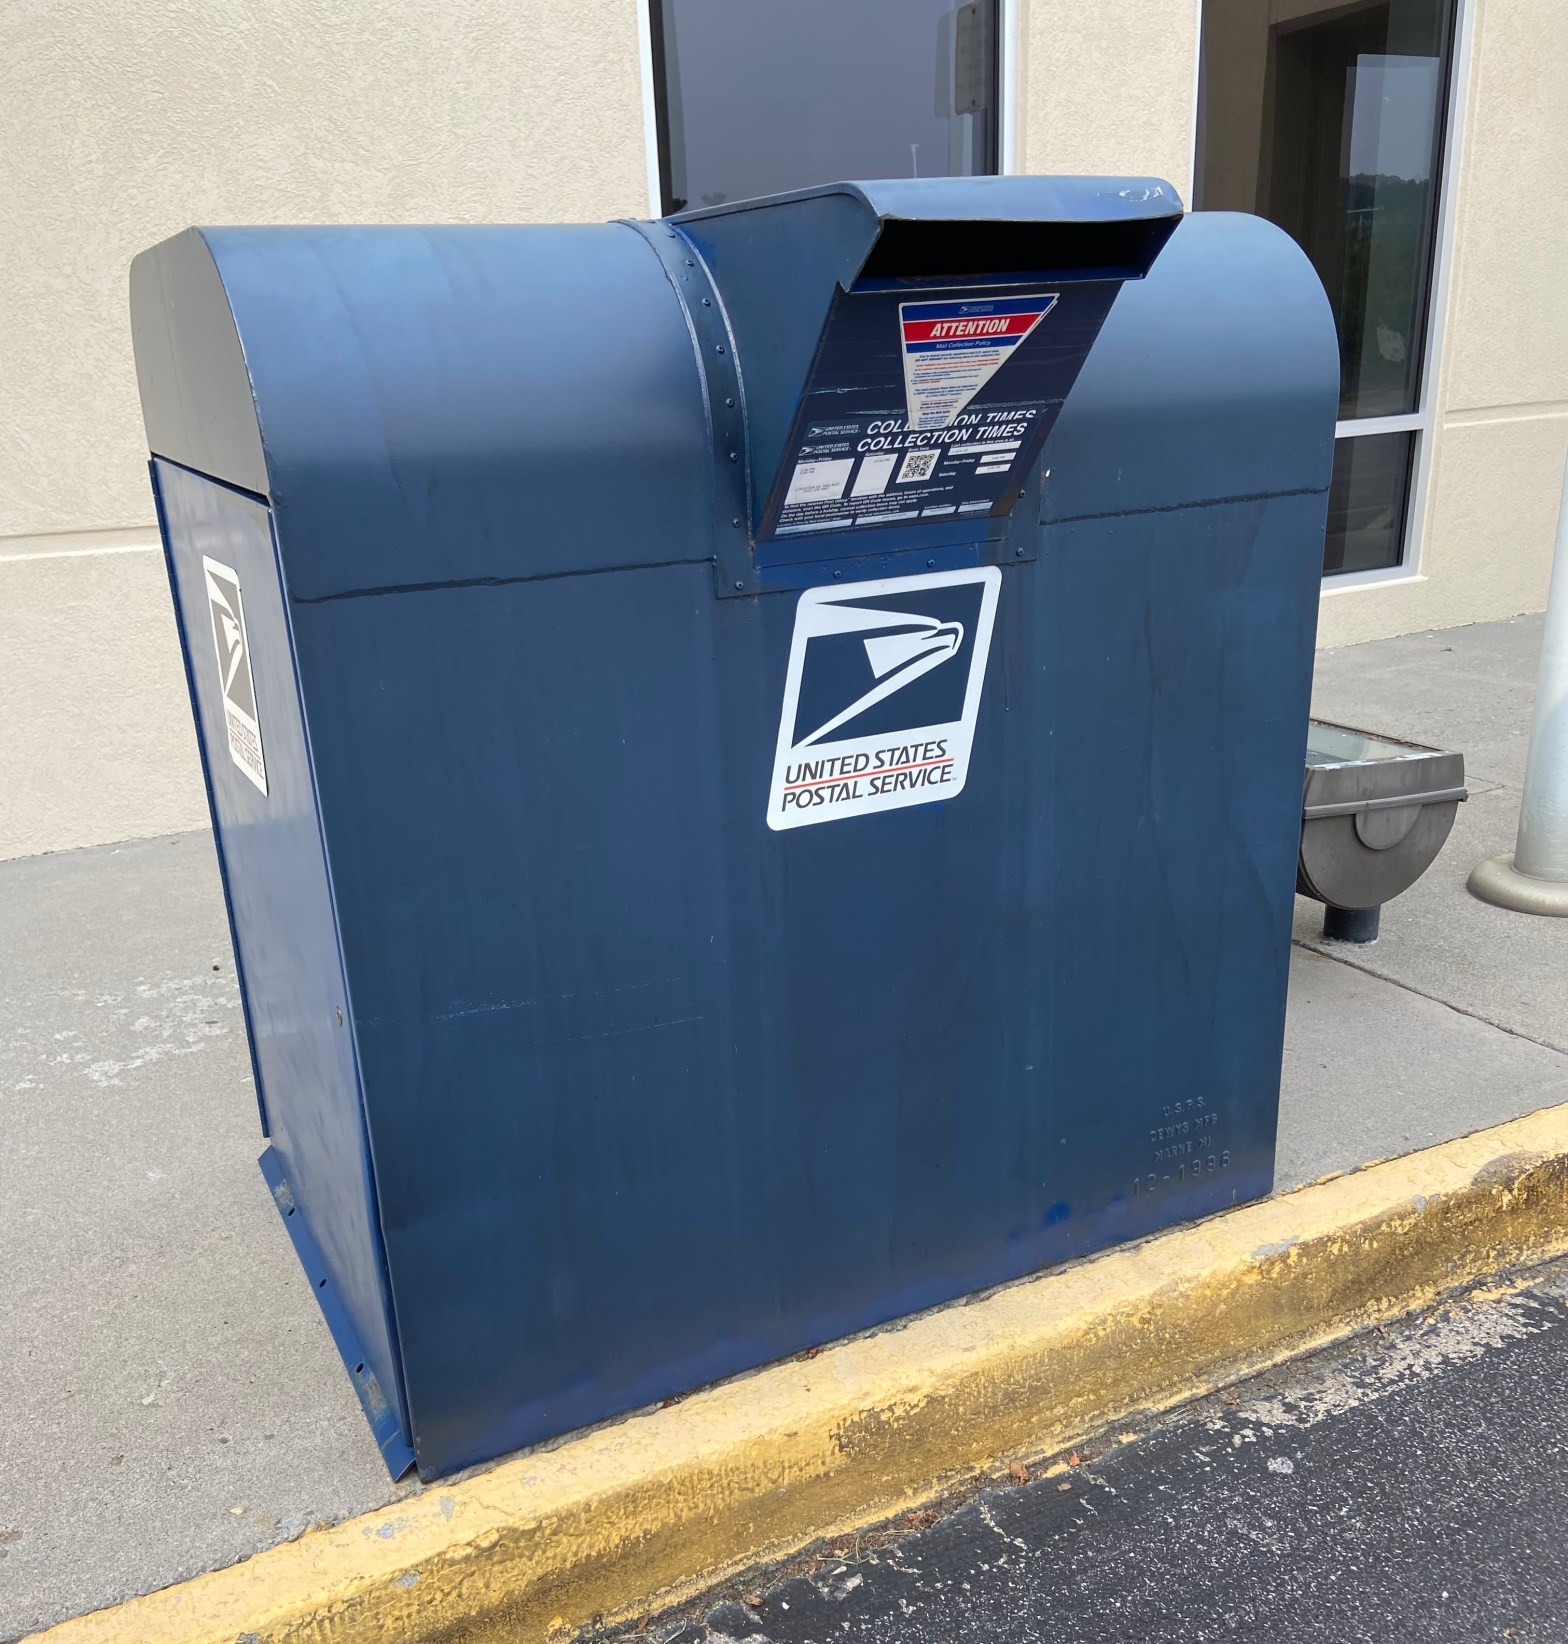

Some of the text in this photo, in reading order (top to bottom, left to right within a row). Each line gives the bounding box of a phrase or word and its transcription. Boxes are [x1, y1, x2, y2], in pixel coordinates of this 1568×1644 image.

[930, 318, 1010, 338] ATTENTION
[857, 422, 1028, 452] COLLECTION TIMES
[867, 414, 982, 434] COLLION
[227, 710, 258, 752] UNITED STATES
[244, 747, 264, 780] SERVICE
[785, 739, 948, 784] UNITED STATES
[782, 764, 954, 812] POSTAL SERVICE
[1154, 1136, 1211, 1162] MARNE MI
